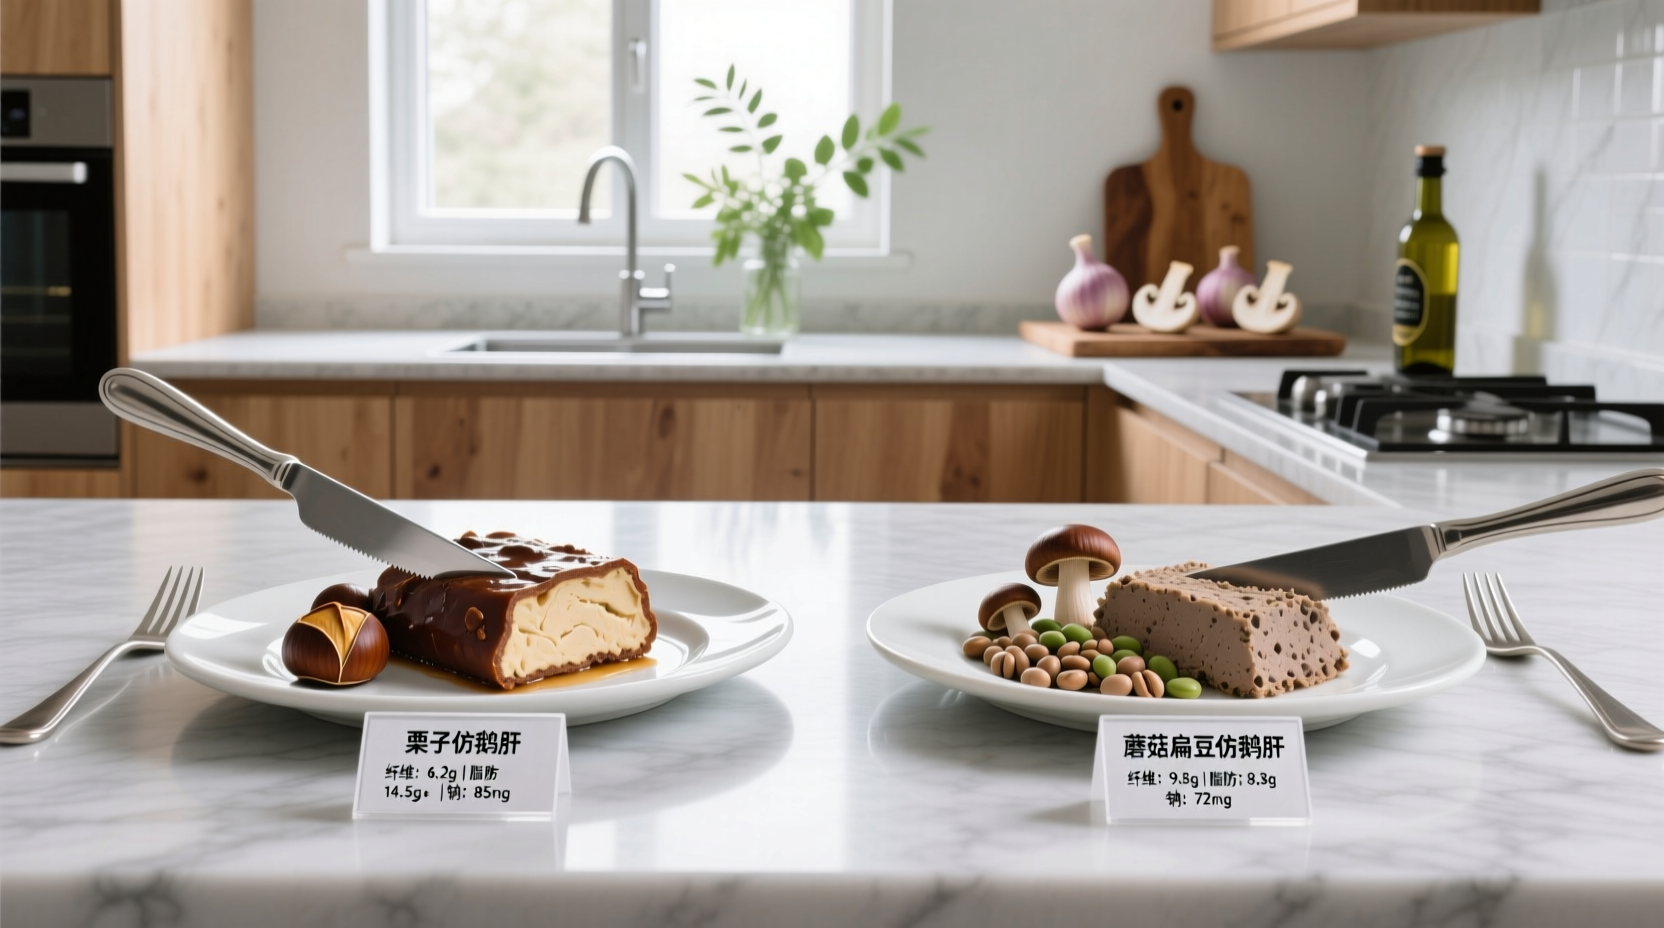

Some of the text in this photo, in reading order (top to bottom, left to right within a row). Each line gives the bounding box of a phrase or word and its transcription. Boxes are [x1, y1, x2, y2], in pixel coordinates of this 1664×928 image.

[405, 730, 521, 755] 栗子仿鹅肝
[1123, 734, 1285, 759] 蘑菇扁豆仿鹅肝
